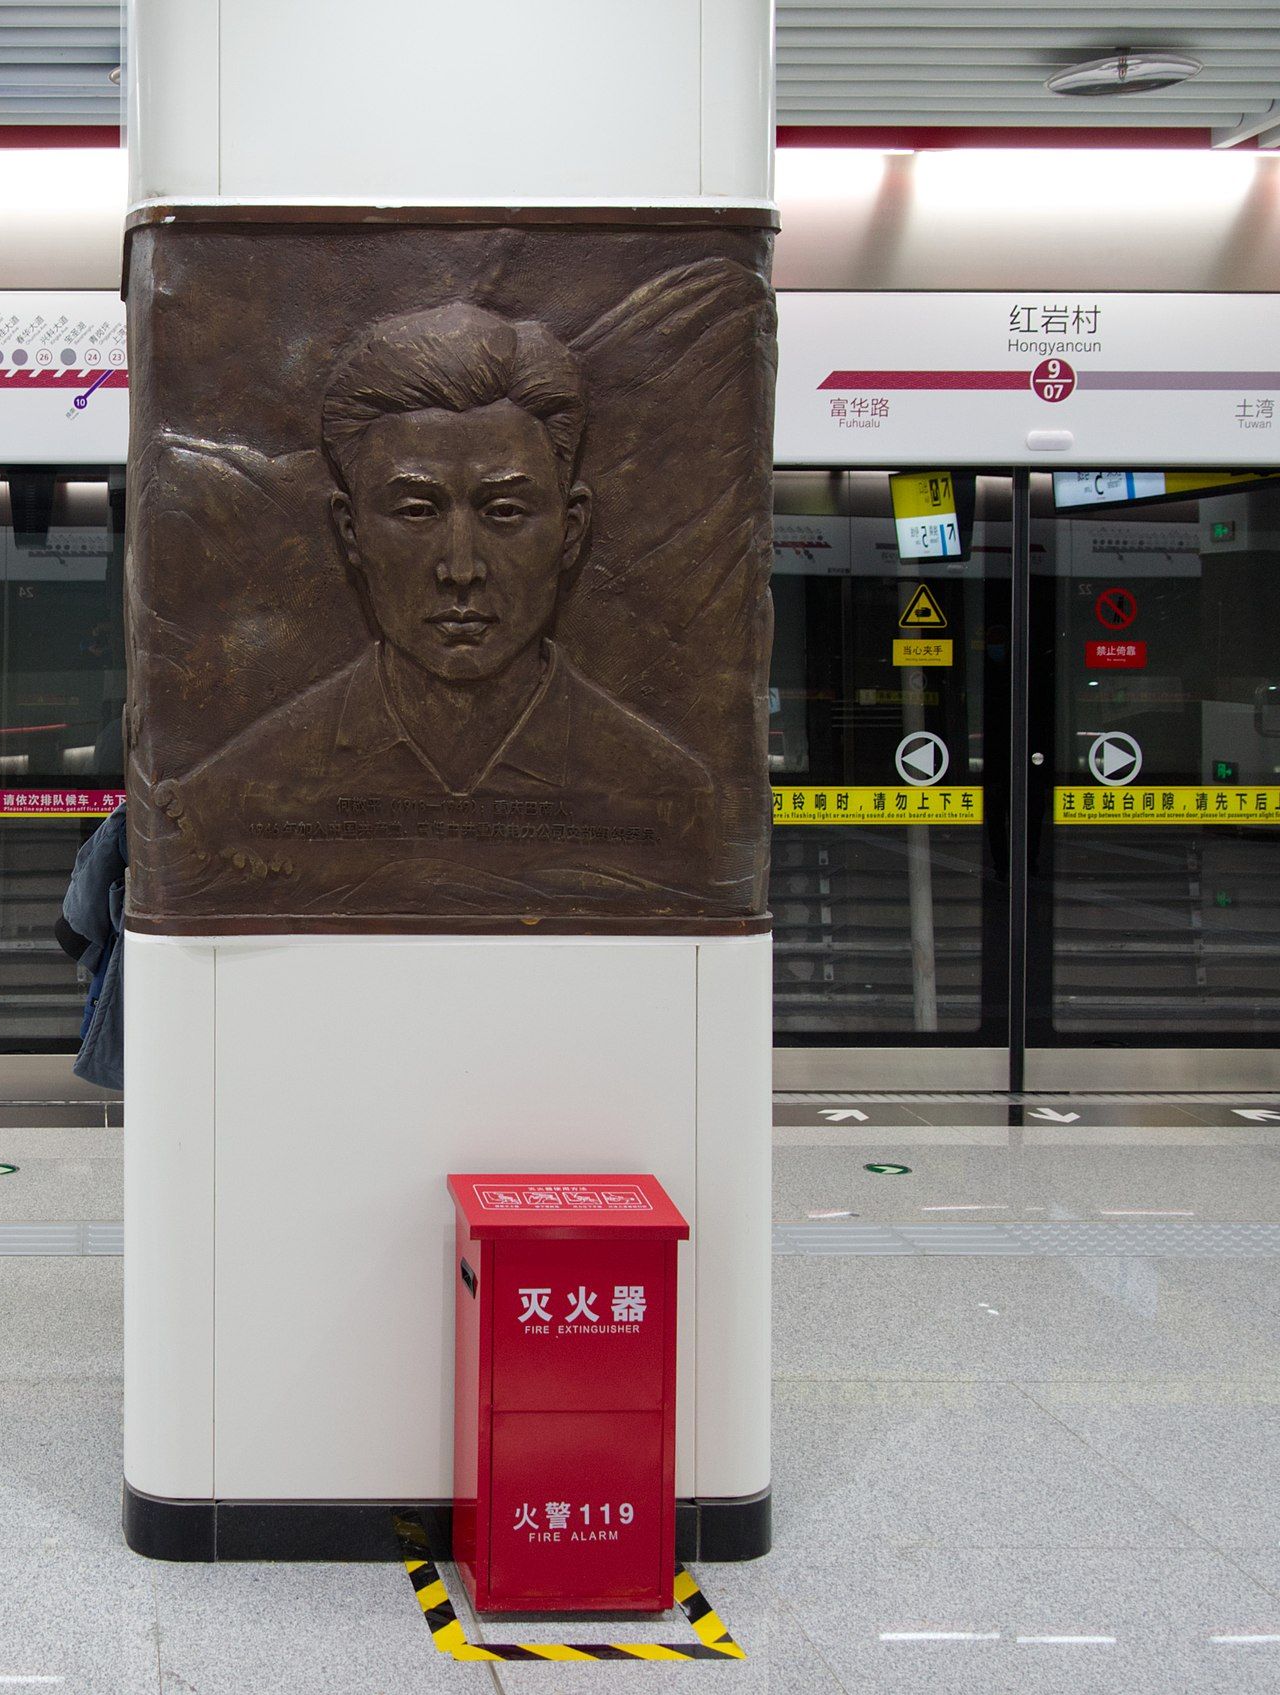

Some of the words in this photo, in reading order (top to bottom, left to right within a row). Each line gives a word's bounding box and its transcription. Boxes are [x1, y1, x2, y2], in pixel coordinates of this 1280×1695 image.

[1009, 304, 1101, 334] 红岩村
[16, 315, 44, 344] 春华大道
[41, 315, 68, 344] 兴科大道
[64, 321, 86, 344] 宝圣湖
[1008, 339, 1101, 355] Hongyancun
[1047, 360, 1061, 379] 9
[1043, 384, 1064, 399] 07
[830, 397, 889, 417] 富华路
[1235, 398, 1275, 418] 土湾
[839, 418, 880, 428] Fuhualu
[1238, 419, 1272, 428] Tuwan
[903, 645, 943, 655] 当心夹手
[1096, 645, 1136, 656] 禁止倚靠
[518, 1286, 647, 1322] 灭火器
[525, 1325, 550, 1334] FIRE
[558, 1324, 640, 1334] EXTINGUISHER
[513, 1501, 634, 1531] 火警119
[529, 1532, 561, 1542] FIRE
[571, 1530, 618, 1541] ALARM
